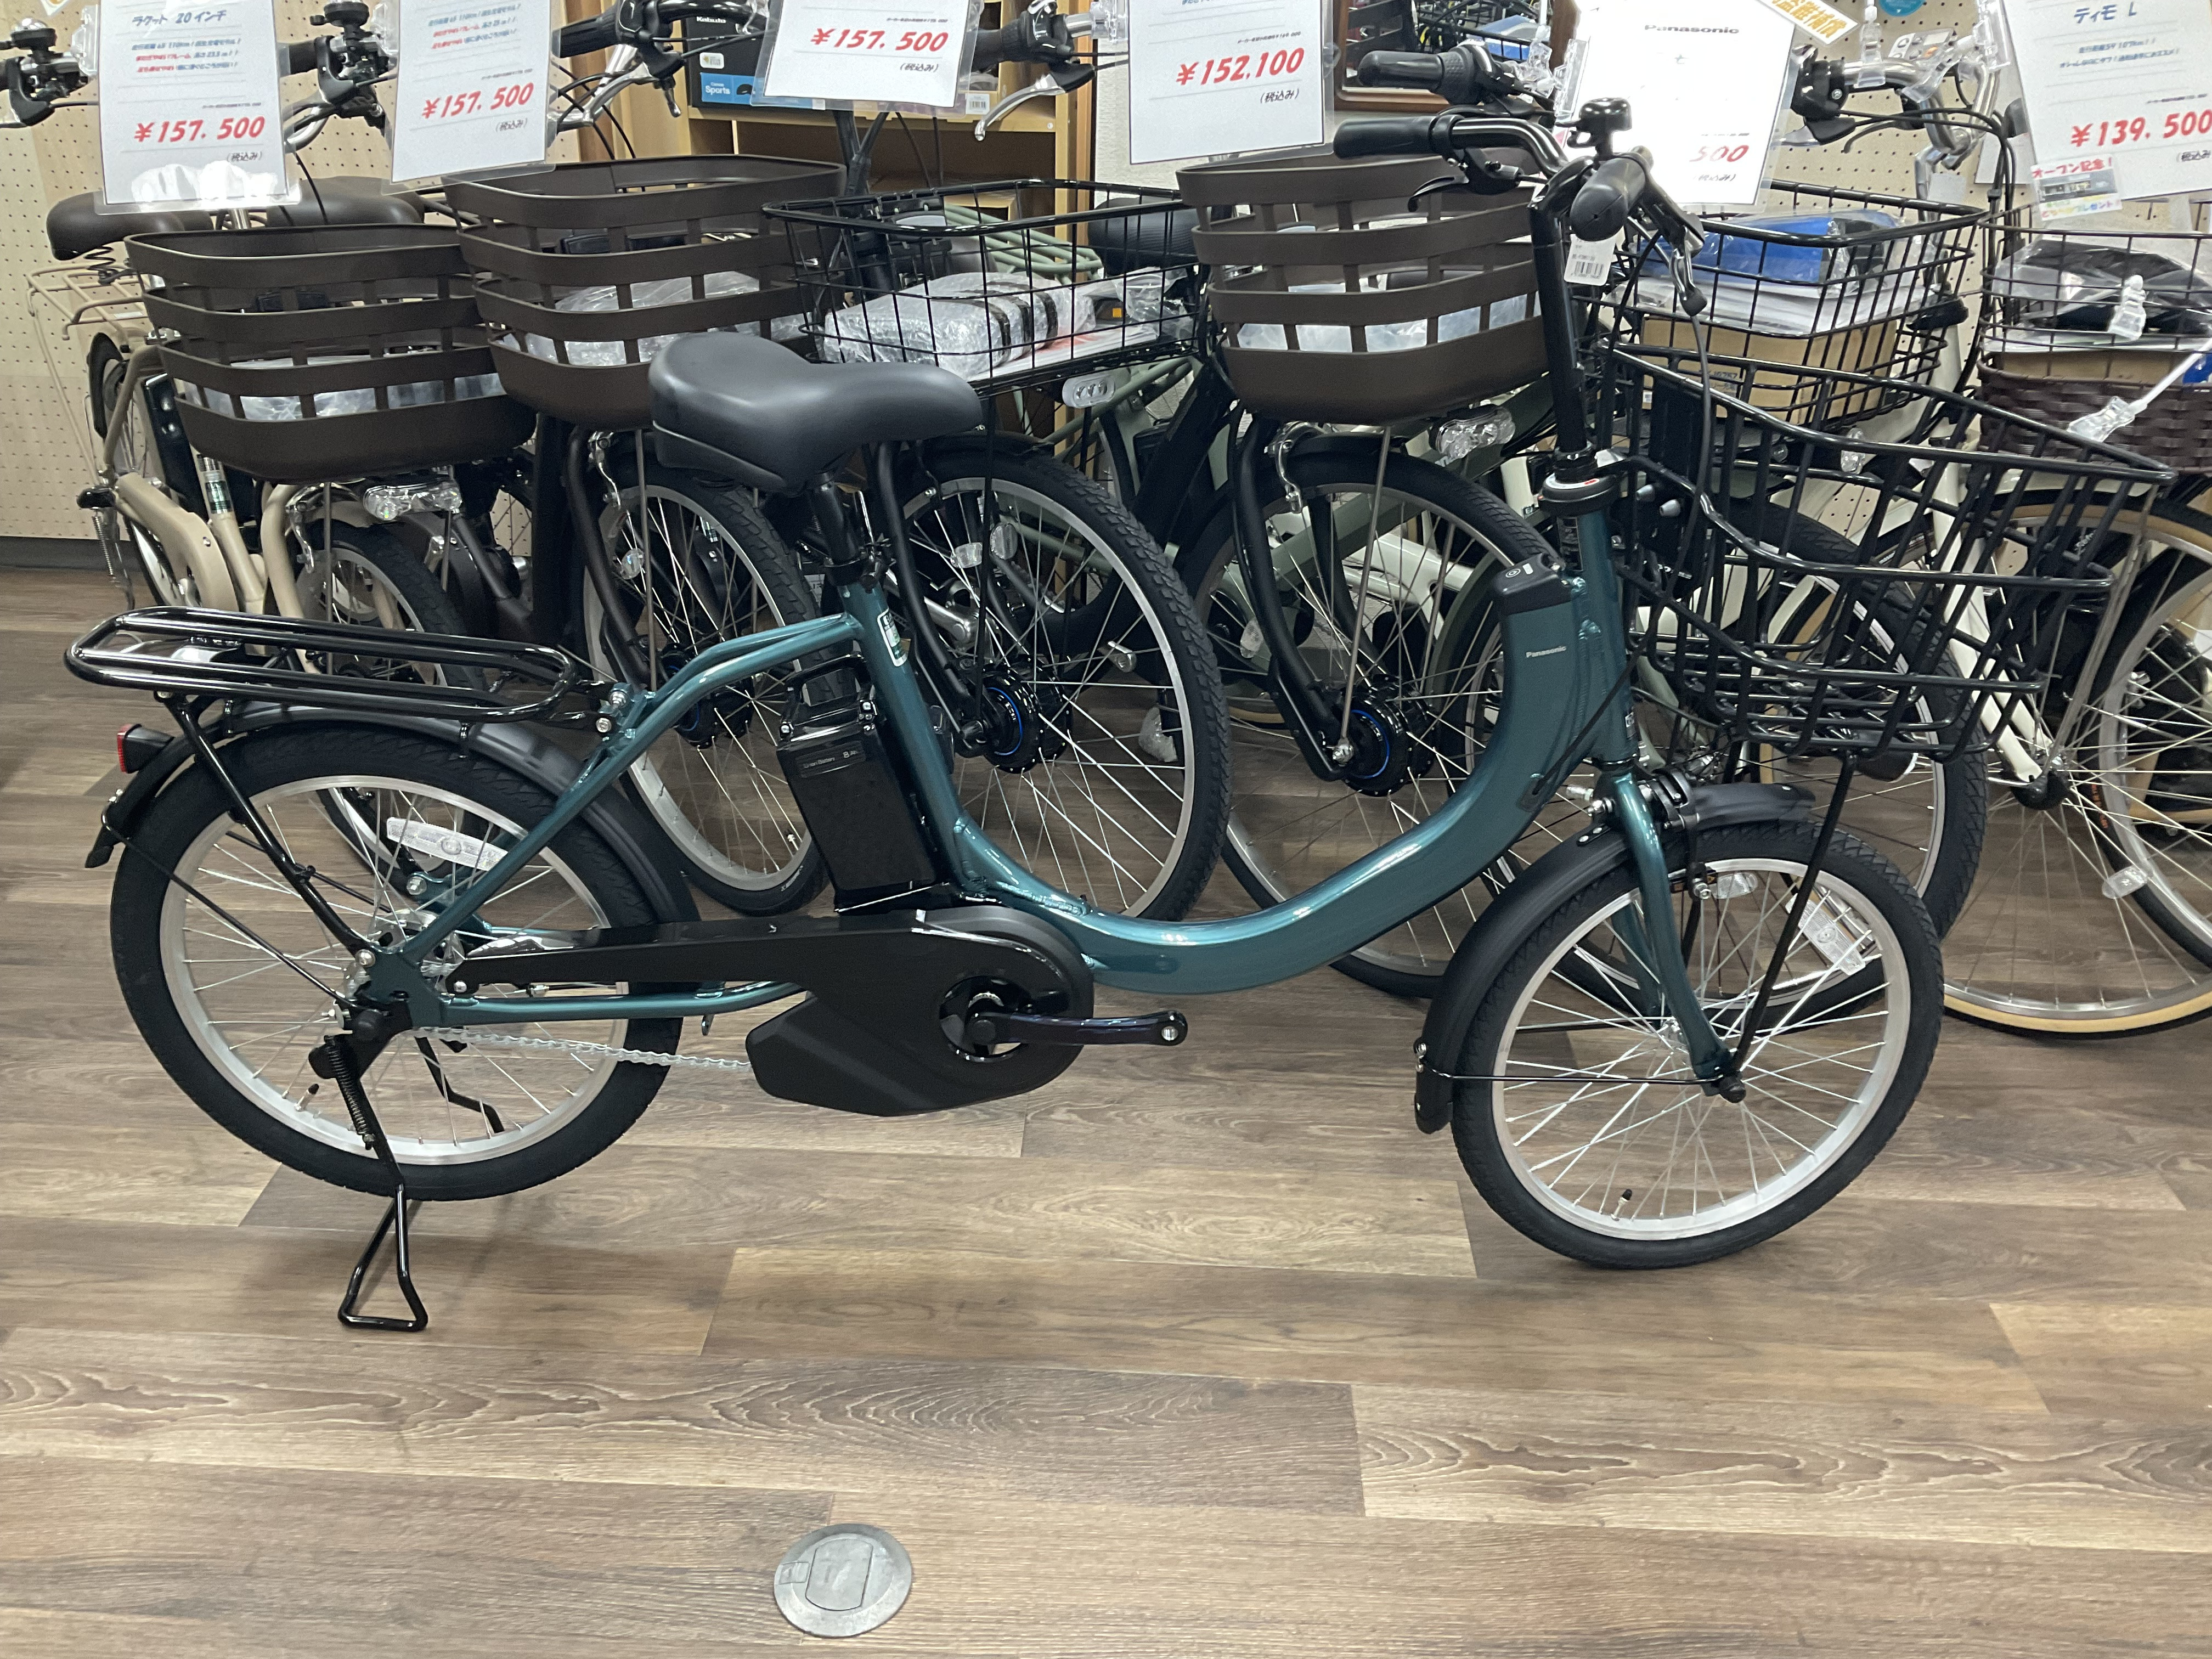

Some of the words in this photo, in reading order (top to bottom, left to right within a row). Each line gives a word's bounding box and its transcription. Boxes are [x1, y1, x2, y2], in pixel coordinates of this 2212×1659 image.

[2073, 4, 2117, 24] ティモ
[1644, 24, 1740, 34] Panasonic
[1176, 47, 1305, 86] ¥152,100
[705, 85, 731, 95] Sports
[1260, 88, 1300, 104] (税込み)
